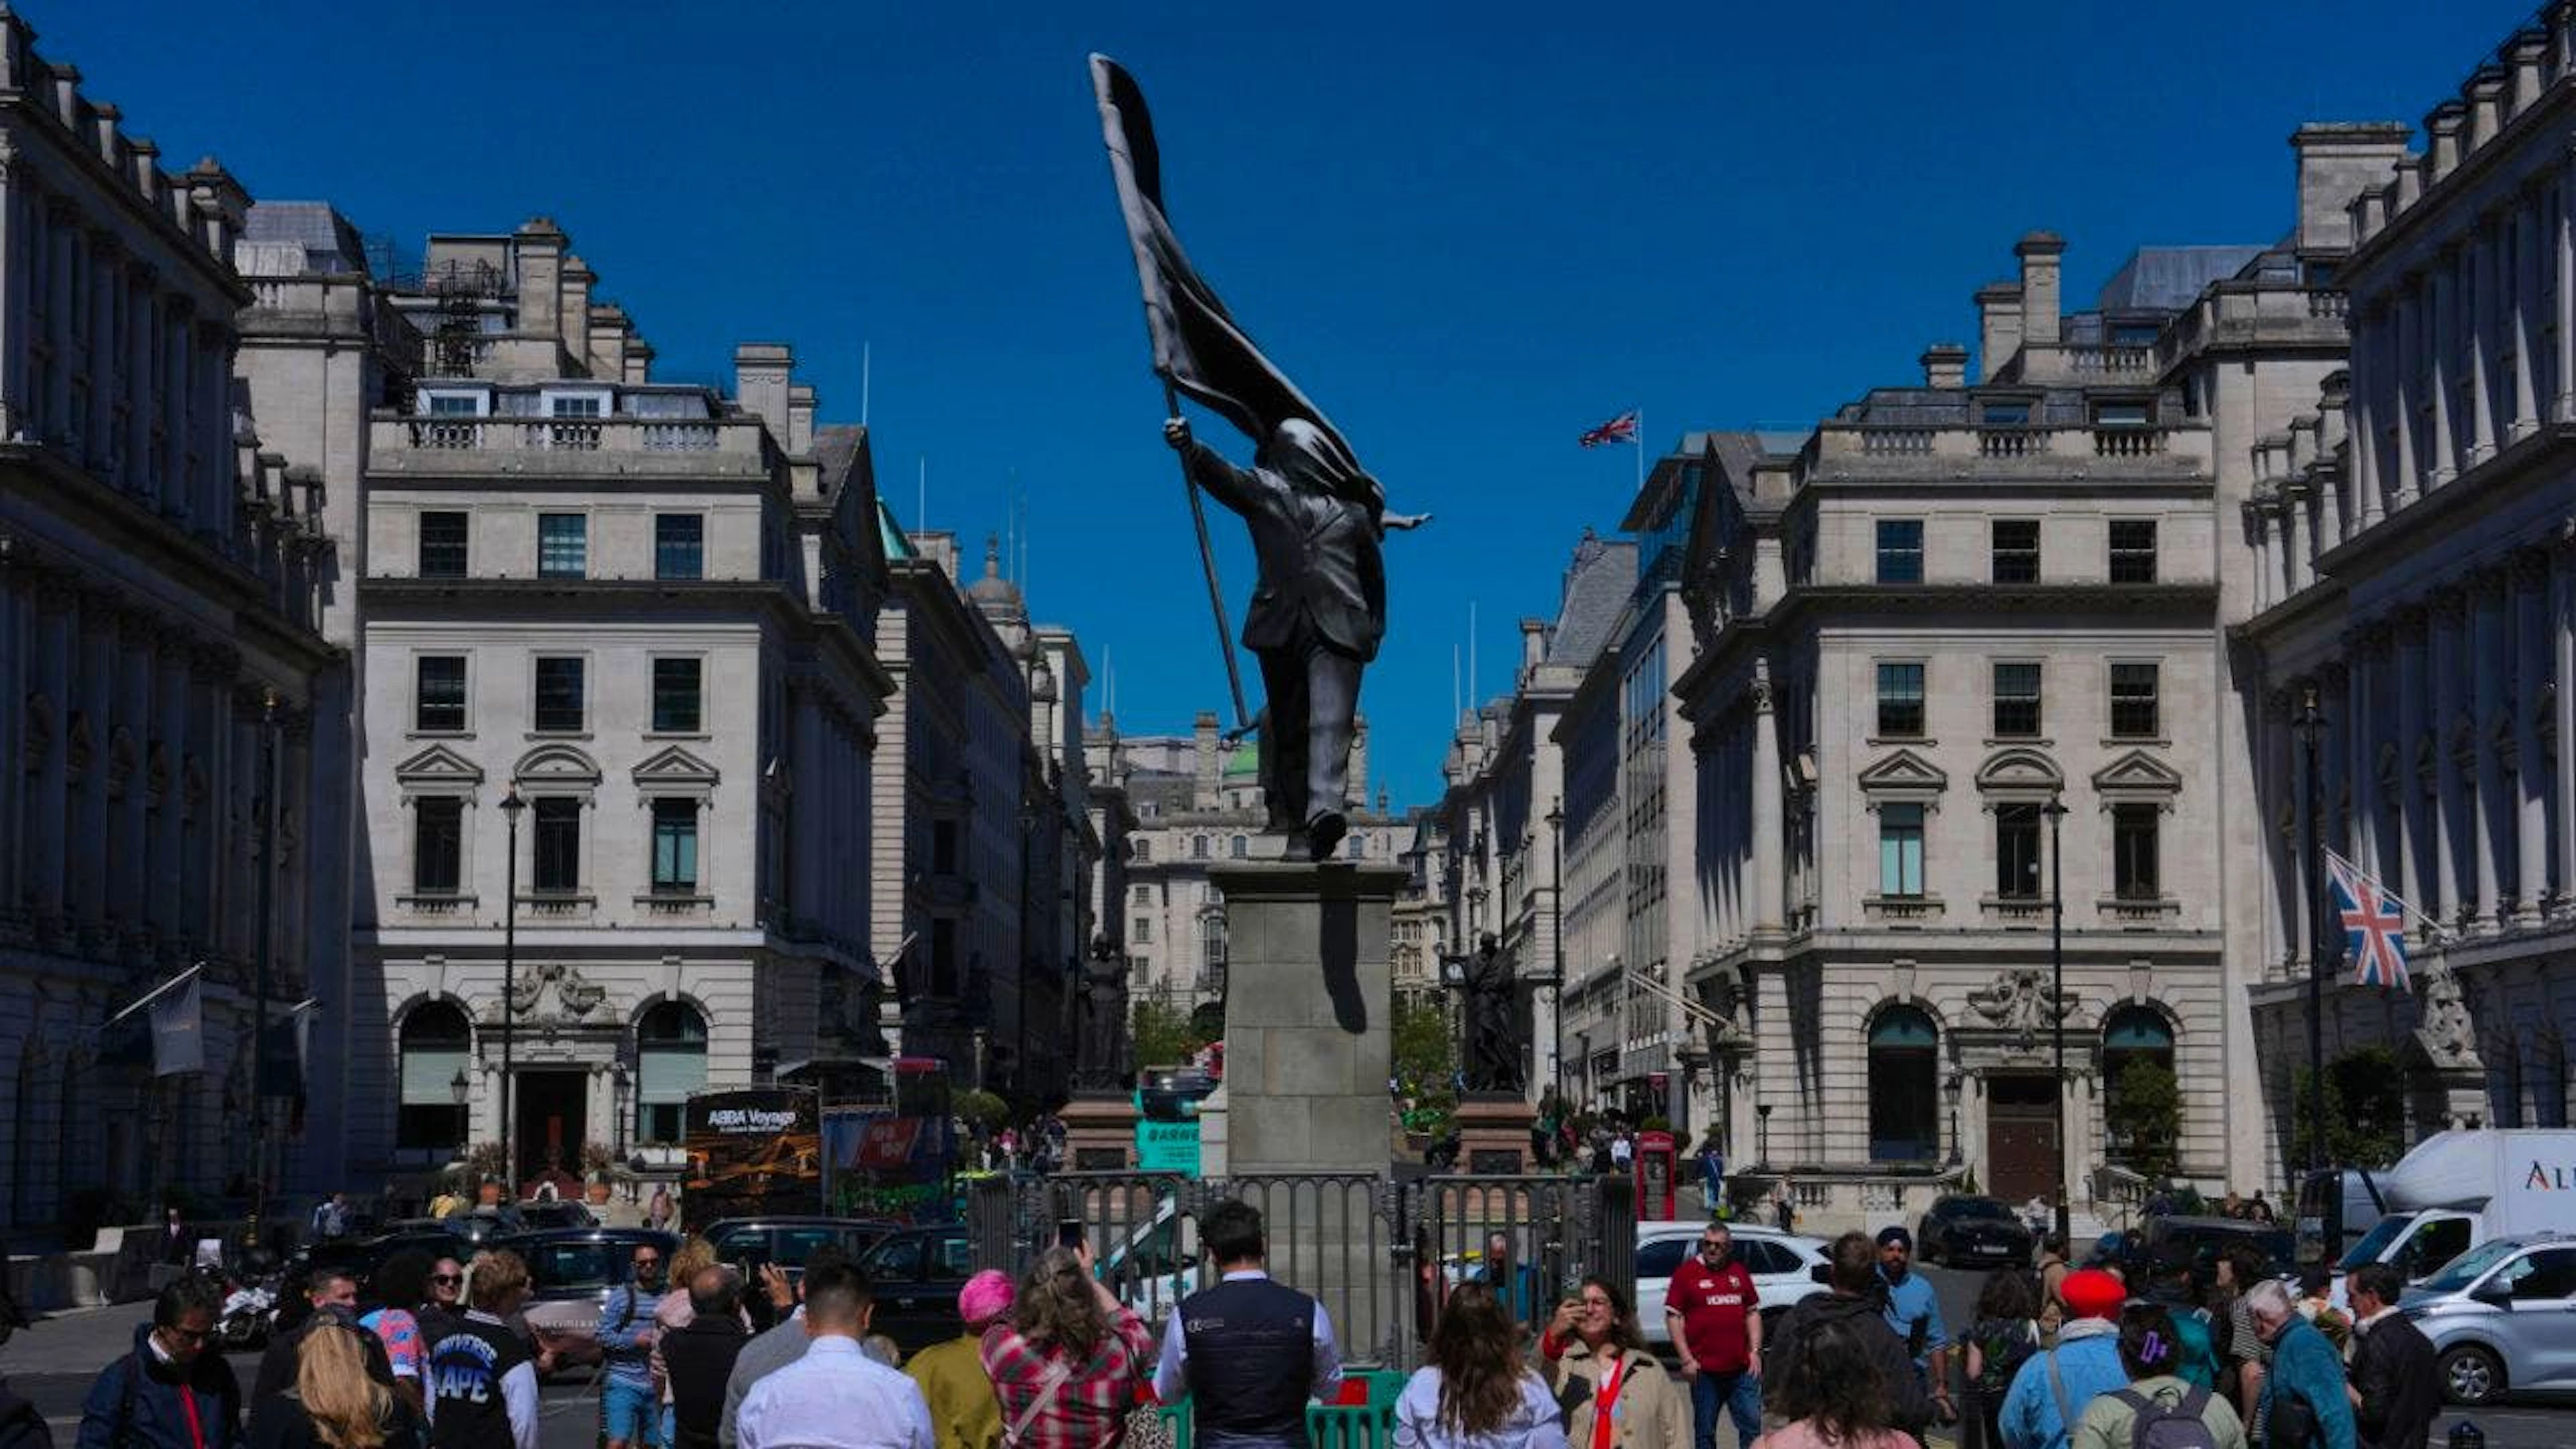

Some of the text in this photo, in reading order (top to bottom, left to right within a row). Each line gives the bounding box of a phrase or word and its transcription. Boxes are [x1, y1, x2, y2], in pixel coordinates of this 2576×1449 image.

[708, 1108, 796, 1126] ABBA Voyage
[2524, 1159, 2576, 1190] AL
